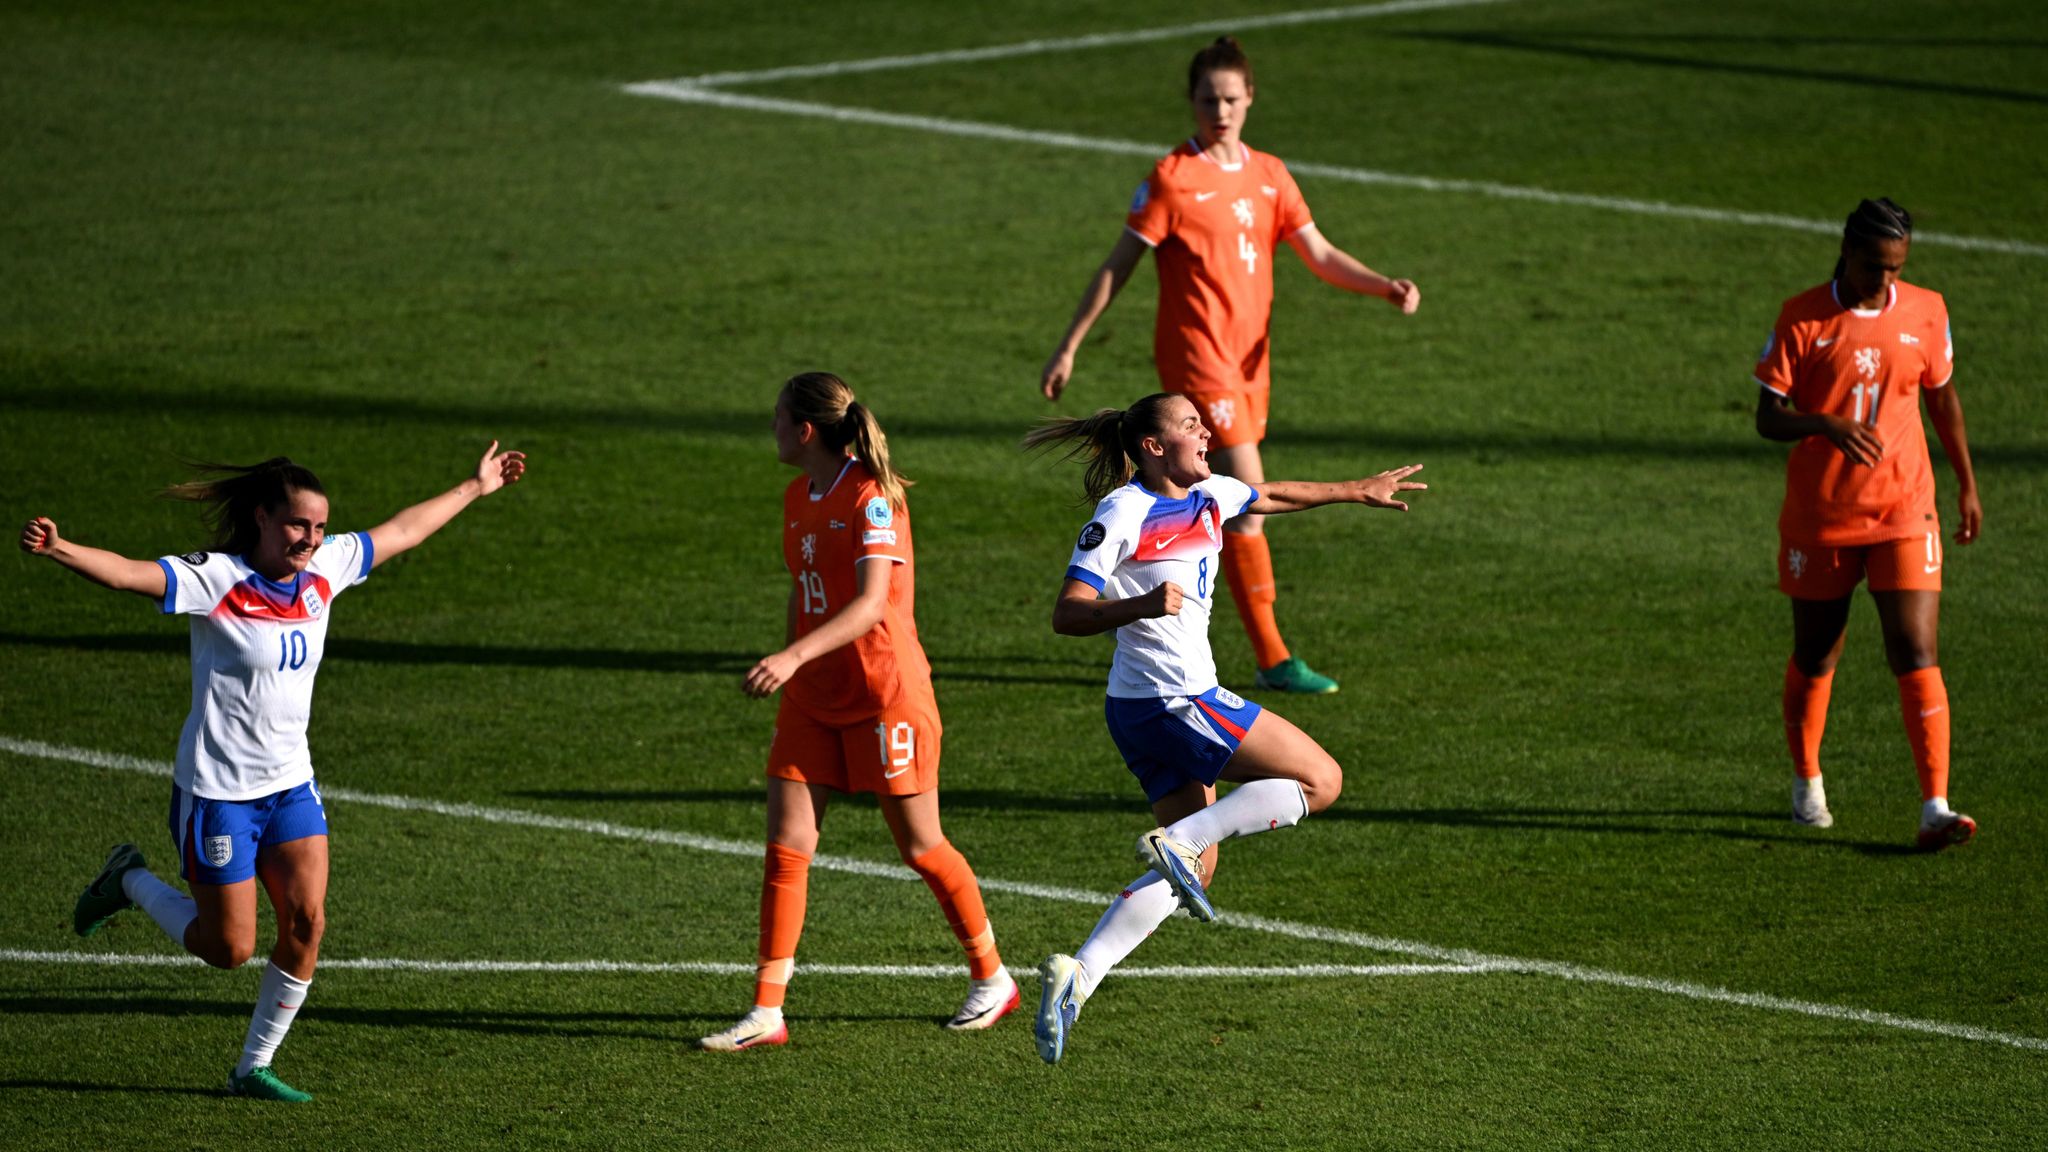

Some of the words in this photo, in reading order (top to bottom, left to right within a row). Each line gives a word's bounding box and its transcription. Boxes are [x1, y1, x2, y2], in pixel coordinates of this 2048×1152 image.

[1238, 232, 1257, 274] 4
[1852, 383, 1879, 425] 11
[799, 570, 828, 614] 19
[1198, 556, 1207, 600] 8
[278, 629, 307, 672] 10
[875, 722, 914, 767] 19
